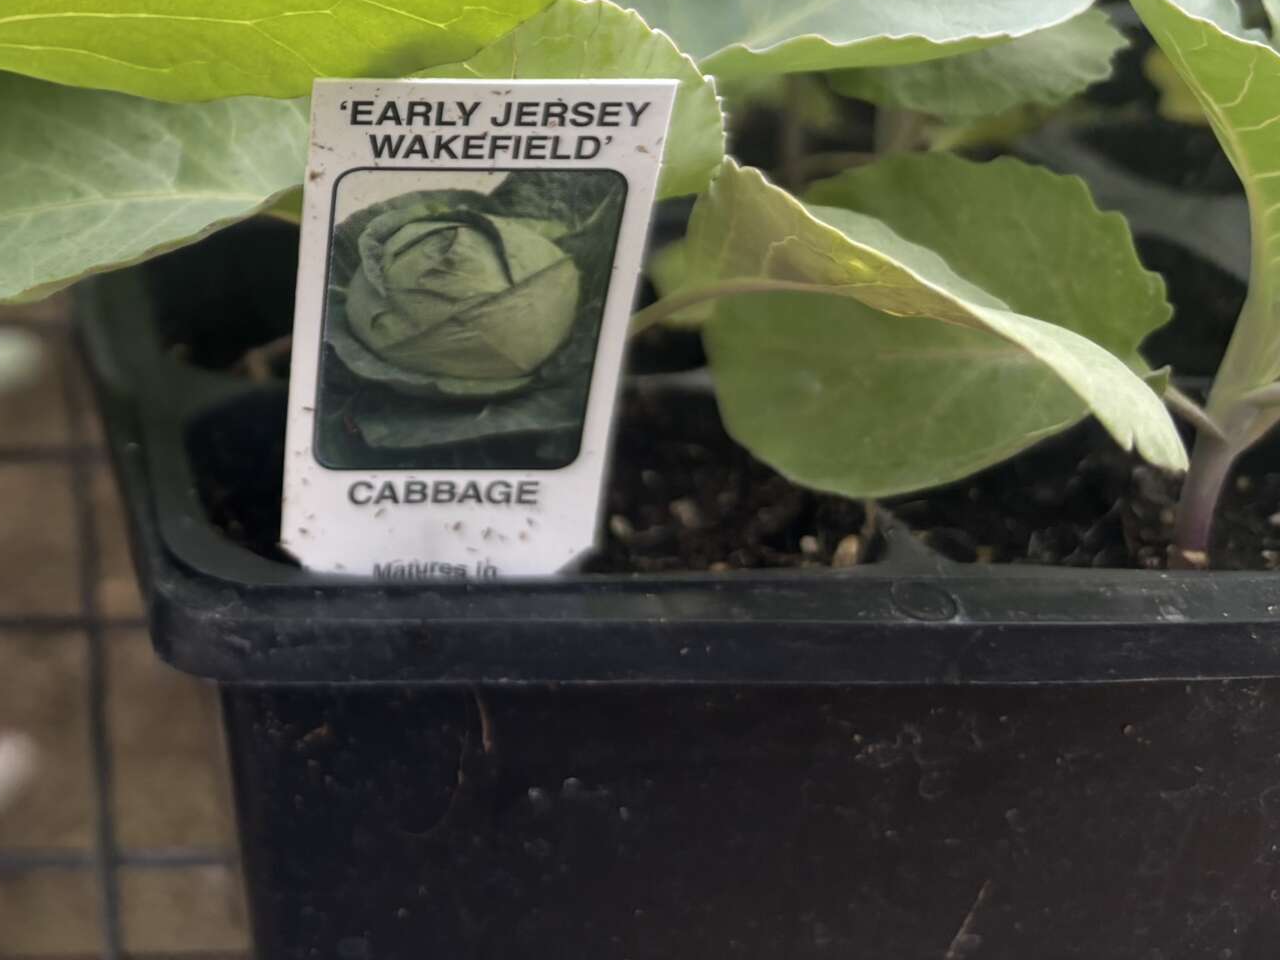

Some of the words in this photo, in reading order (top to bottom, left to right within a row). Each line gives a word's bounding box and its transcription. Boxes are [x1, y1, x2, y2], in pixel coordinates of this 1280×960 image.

[340, 100, 481, 127] ‘EARLY
[490, 100, 651, 127] JERSEY
[369, 134, 613, 160] WAKEFIELD’
[347, 480, 540, 506] CABBAGE
